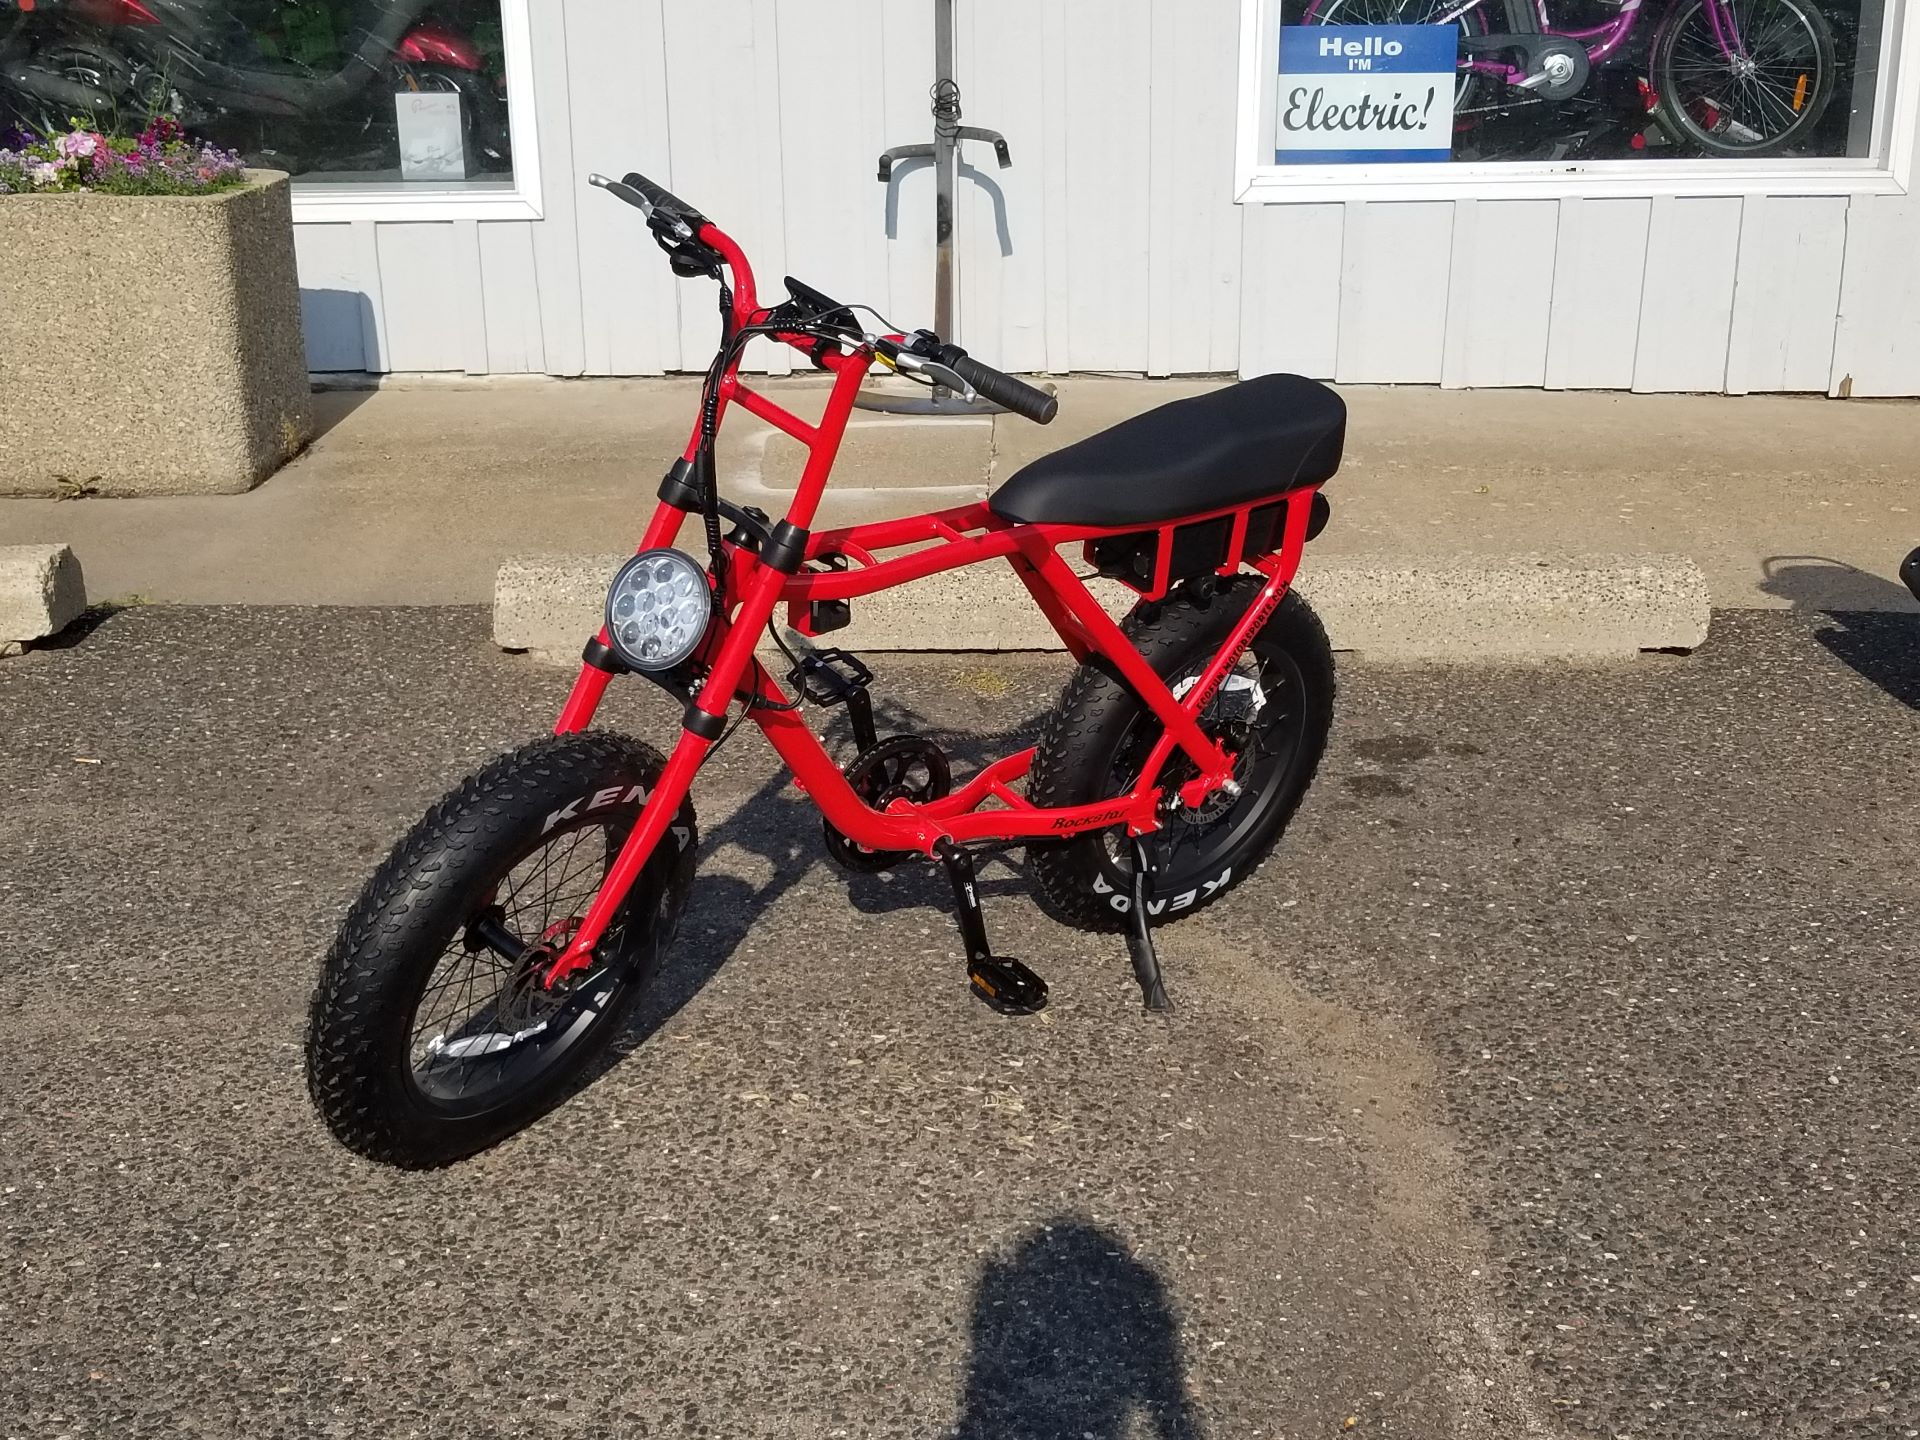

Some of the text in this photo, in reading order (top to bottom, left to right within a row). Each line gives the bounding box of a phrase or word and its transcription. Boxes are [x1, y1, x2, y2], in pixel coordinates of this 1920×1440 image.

[1319, 36, 1403, 57] Hello
[1348, 58, 1372, 71] I'M
[1282, 86, 1435, 132] Electric!
[540, 785, 691, 852] KENA
